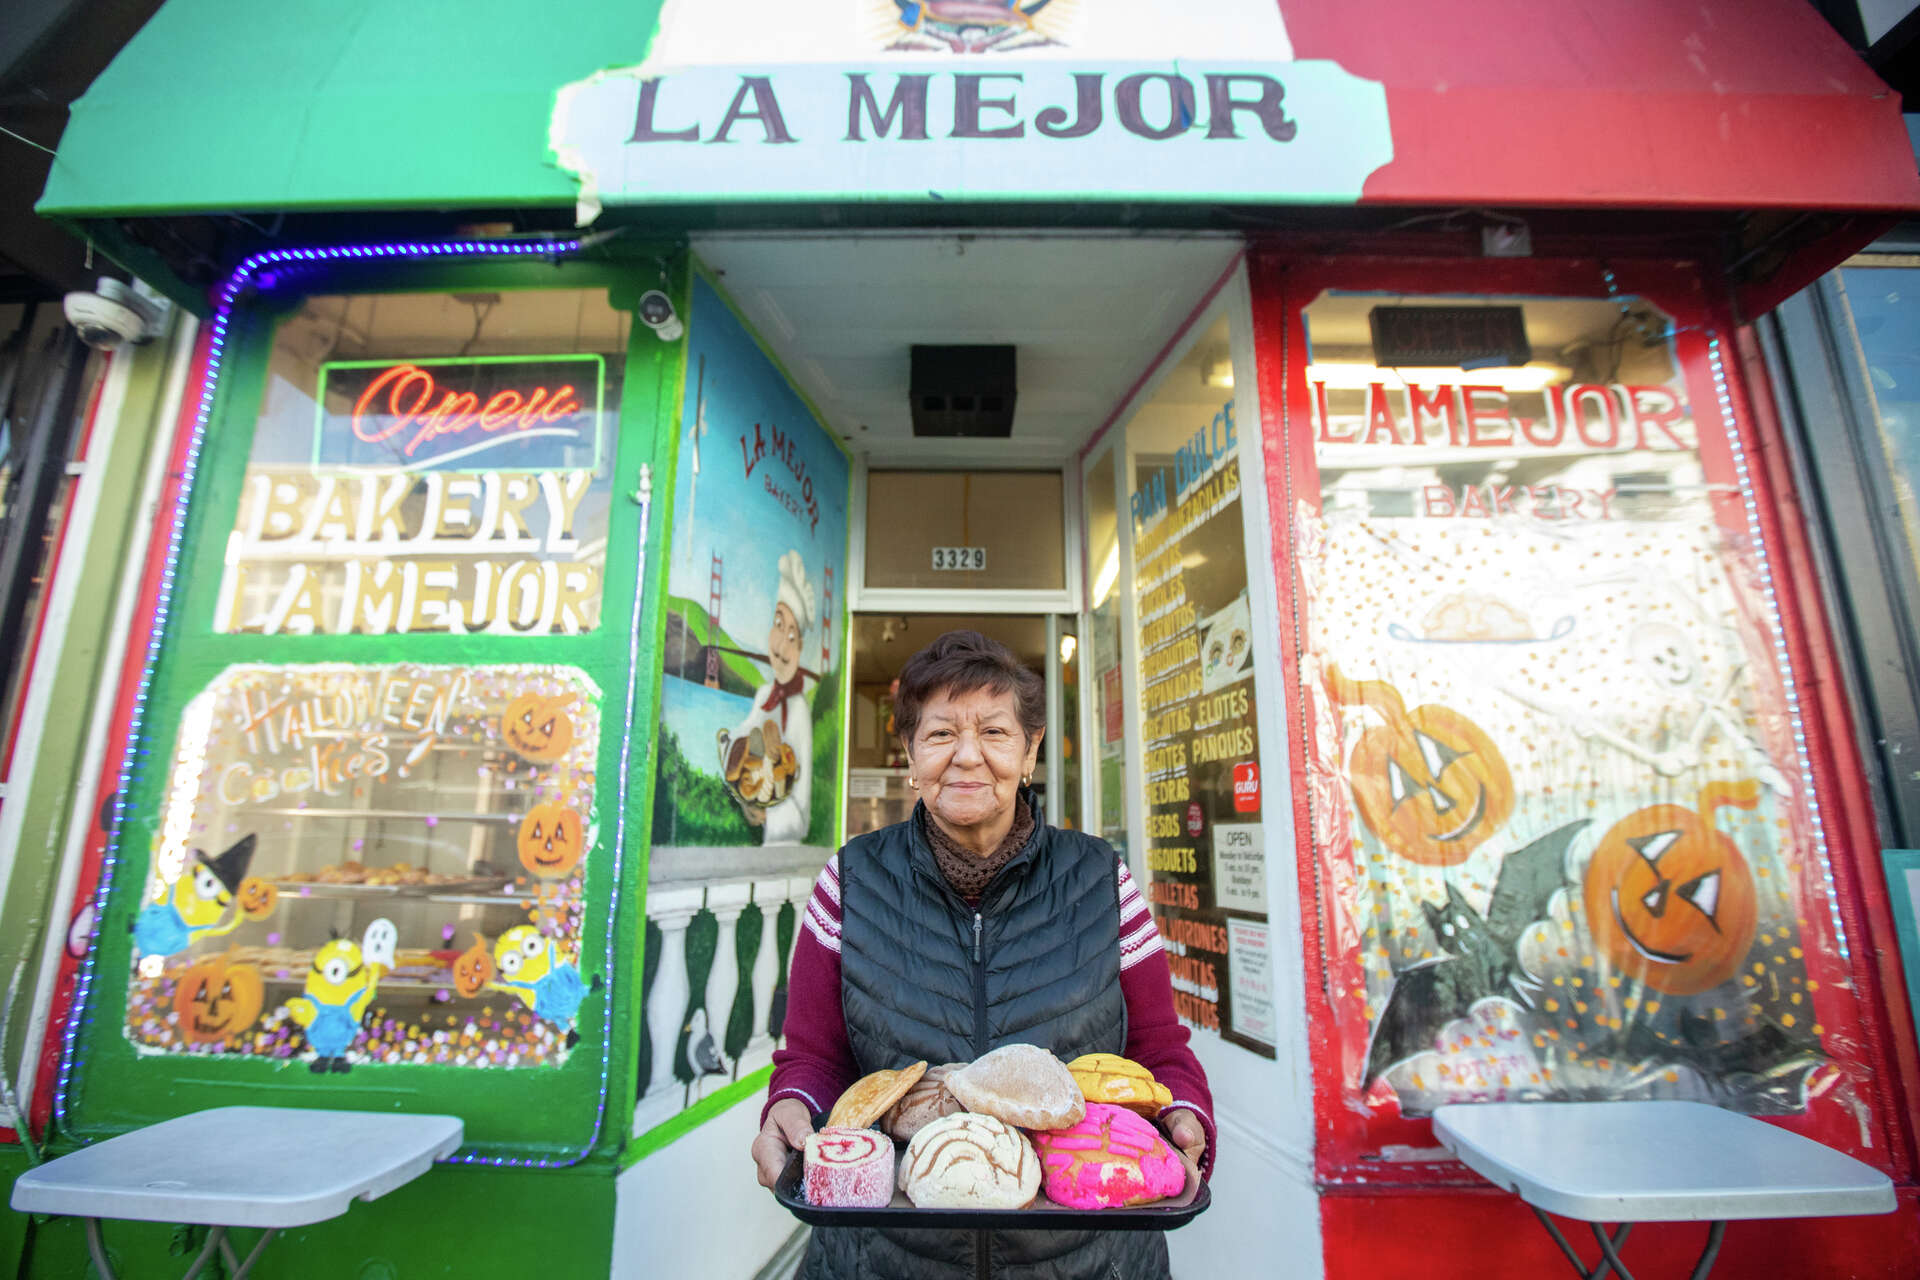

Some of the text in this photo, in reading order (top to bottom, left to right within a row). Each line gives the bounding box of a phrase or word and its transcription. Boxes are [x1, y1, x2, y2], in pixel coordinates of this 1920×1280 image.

[625, 71, 1298, 144] LA MEJOR
[353, 364, 584, 457] Open
[1174, 399, 1238, 497] DULCE
[242, 471, 594, 553] BAKERY
[1423, 485, 1618, 520] BAKERY
[935, 549, 984, 569] 3329
[336, 560, 600, 635] MEJOR
[1197, 687, 1249, 724] ELOTES
[1191, 725, 1254, 765] PANQUES
[1235, 780, 1258, 795] GURU
[1227, 831, 1252, 847] OPEN
